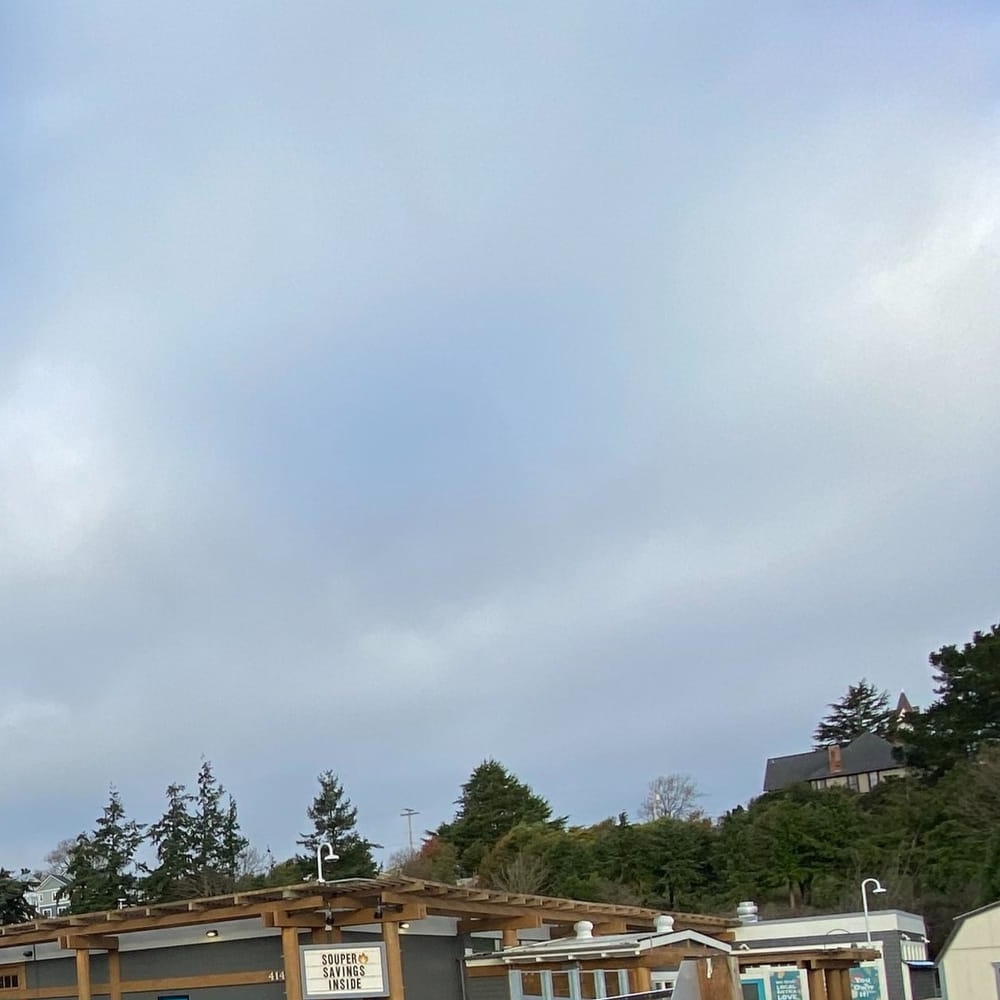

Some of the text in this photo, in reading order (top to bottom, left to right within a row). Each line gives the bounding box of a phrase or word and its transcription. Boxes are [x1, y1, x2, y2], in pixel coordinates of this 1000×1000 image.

[321, 953, 358, 966] SOUPER
[268, 970, 286, 981] 414
[323, 965, 366, 978] SAVINGS
[328, 978, 362, 991] INSIDE
